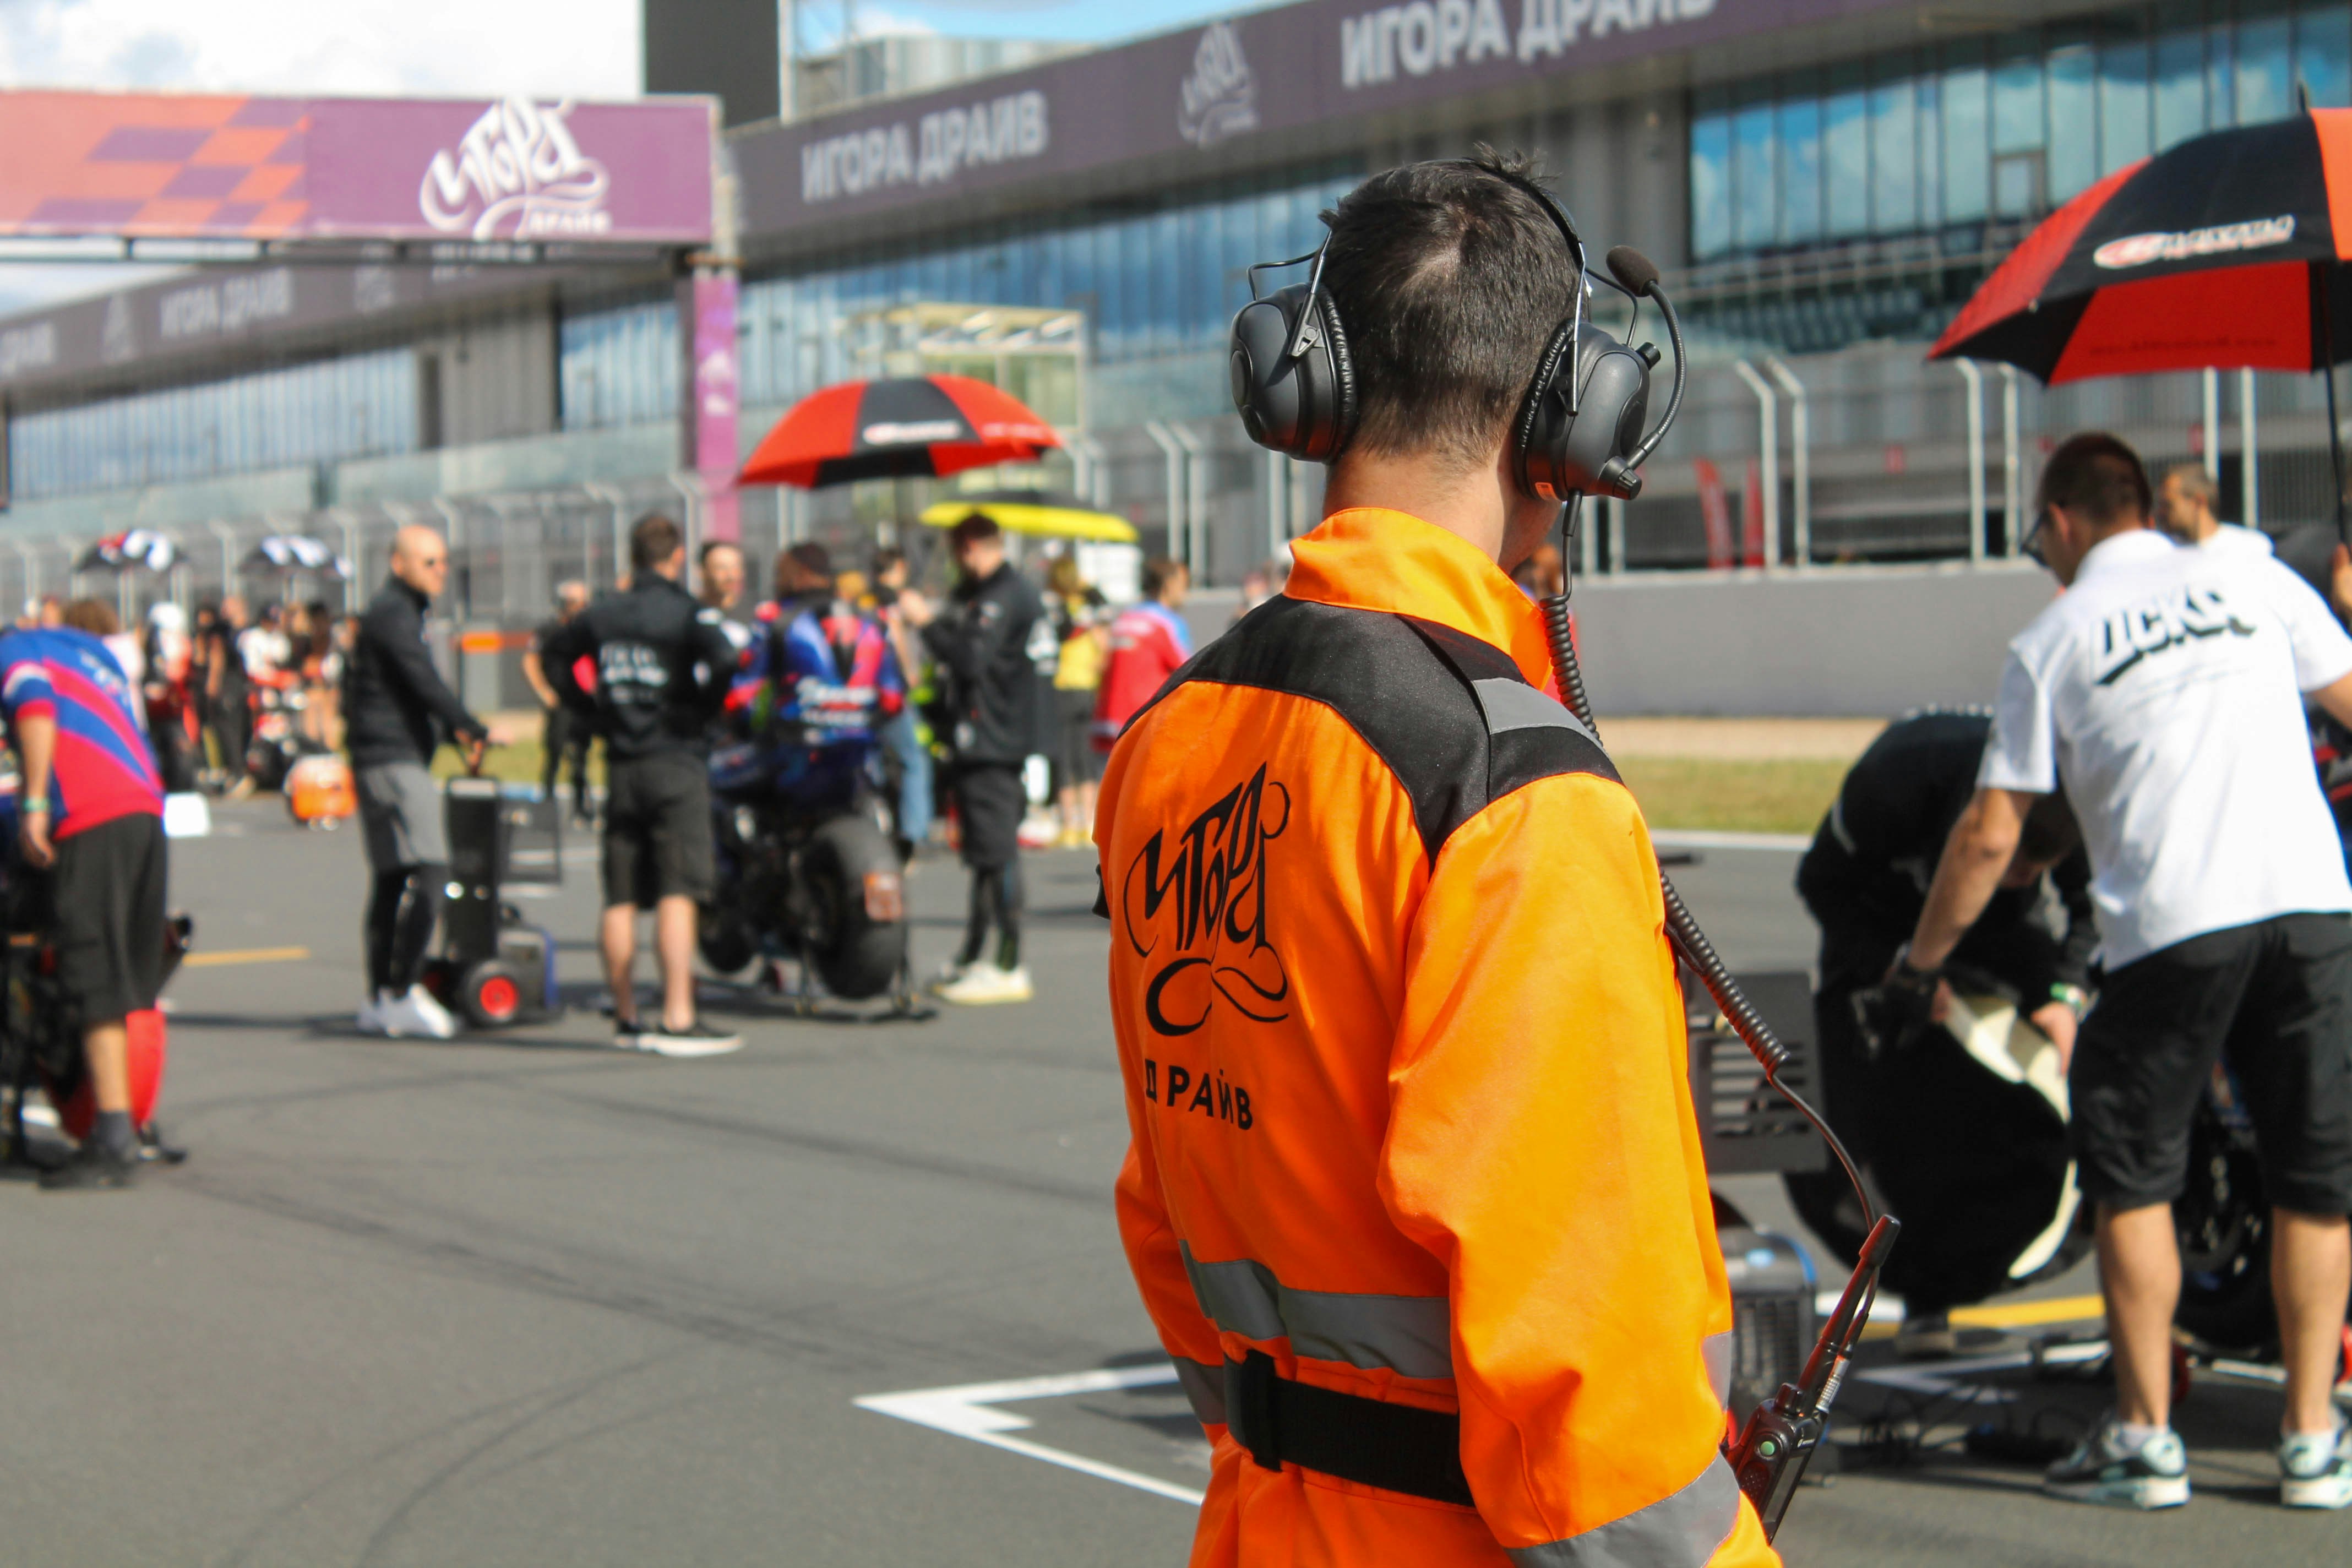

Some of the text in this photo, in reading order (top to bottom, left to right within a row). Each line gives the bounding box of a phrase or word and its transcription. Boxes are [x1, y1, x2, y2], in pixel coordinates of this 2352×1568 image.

[1341, 0, 1510, 87] ИГОРА
[802, 121, 913, 204] ИГОРА
[1145, 1058, 1253, 1130] ДРАЙВ
